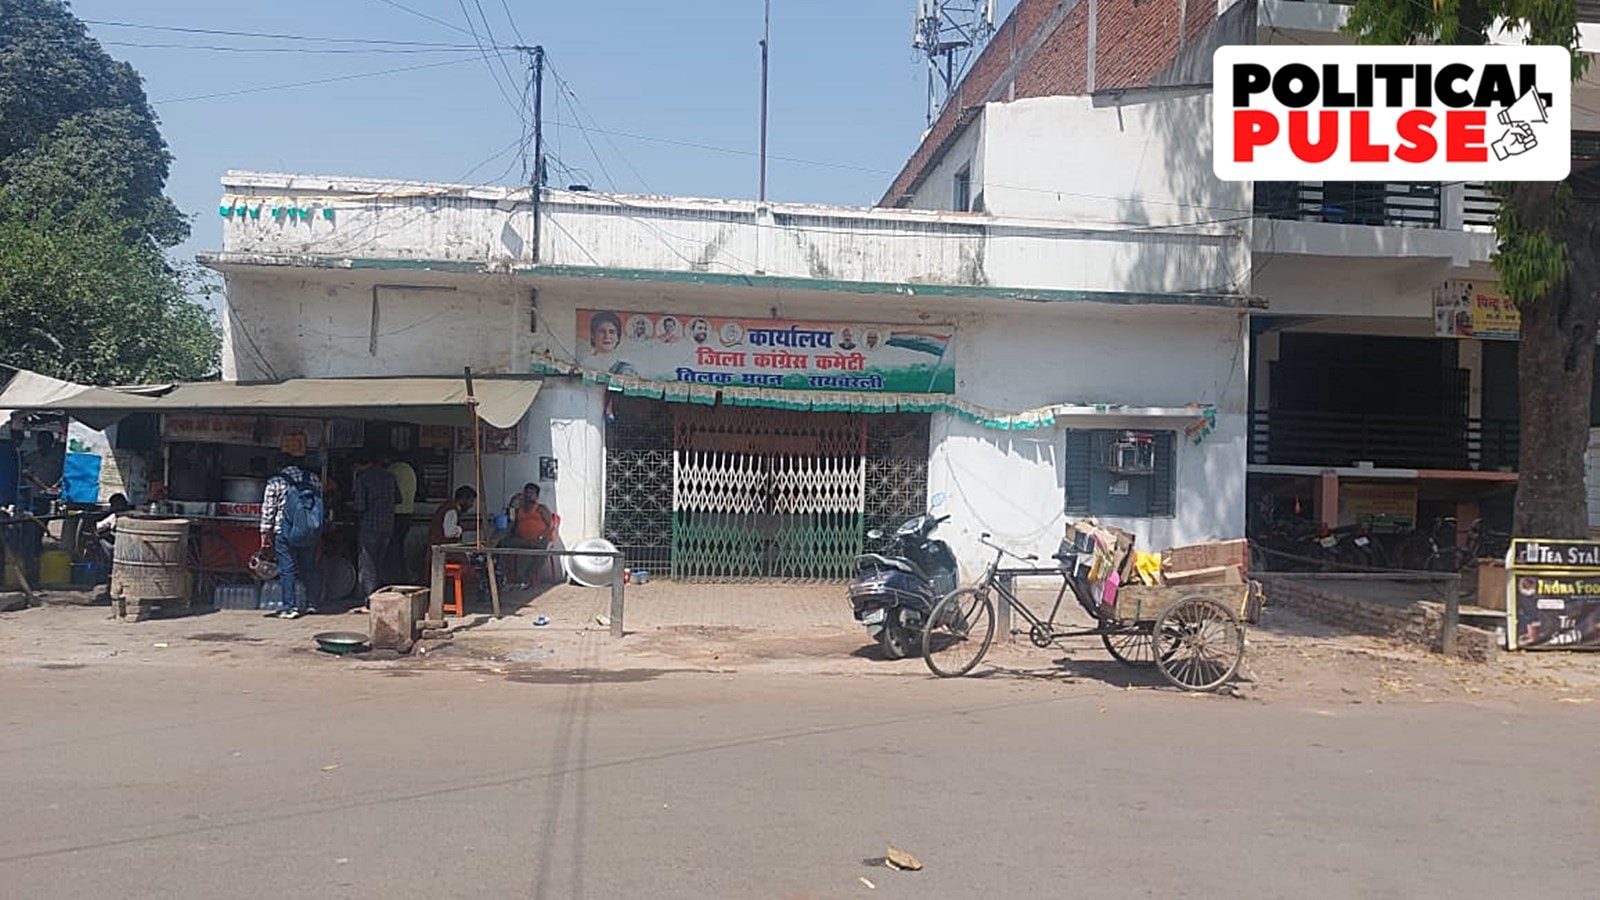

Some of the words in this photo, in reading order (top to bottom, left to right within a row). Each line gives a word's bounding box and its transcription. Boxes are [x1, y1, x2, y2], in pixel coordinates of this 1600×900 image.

[748, 325, 834, 348] कार्यालय
[696, 347, 746, 367] जिला
[753, 350, 809, 370] कांग्रेस
[815, 351, 867, 371] कमेटी
[676, 368, 733, 383] तिलक
[741, 374, 784, 387] भवन
